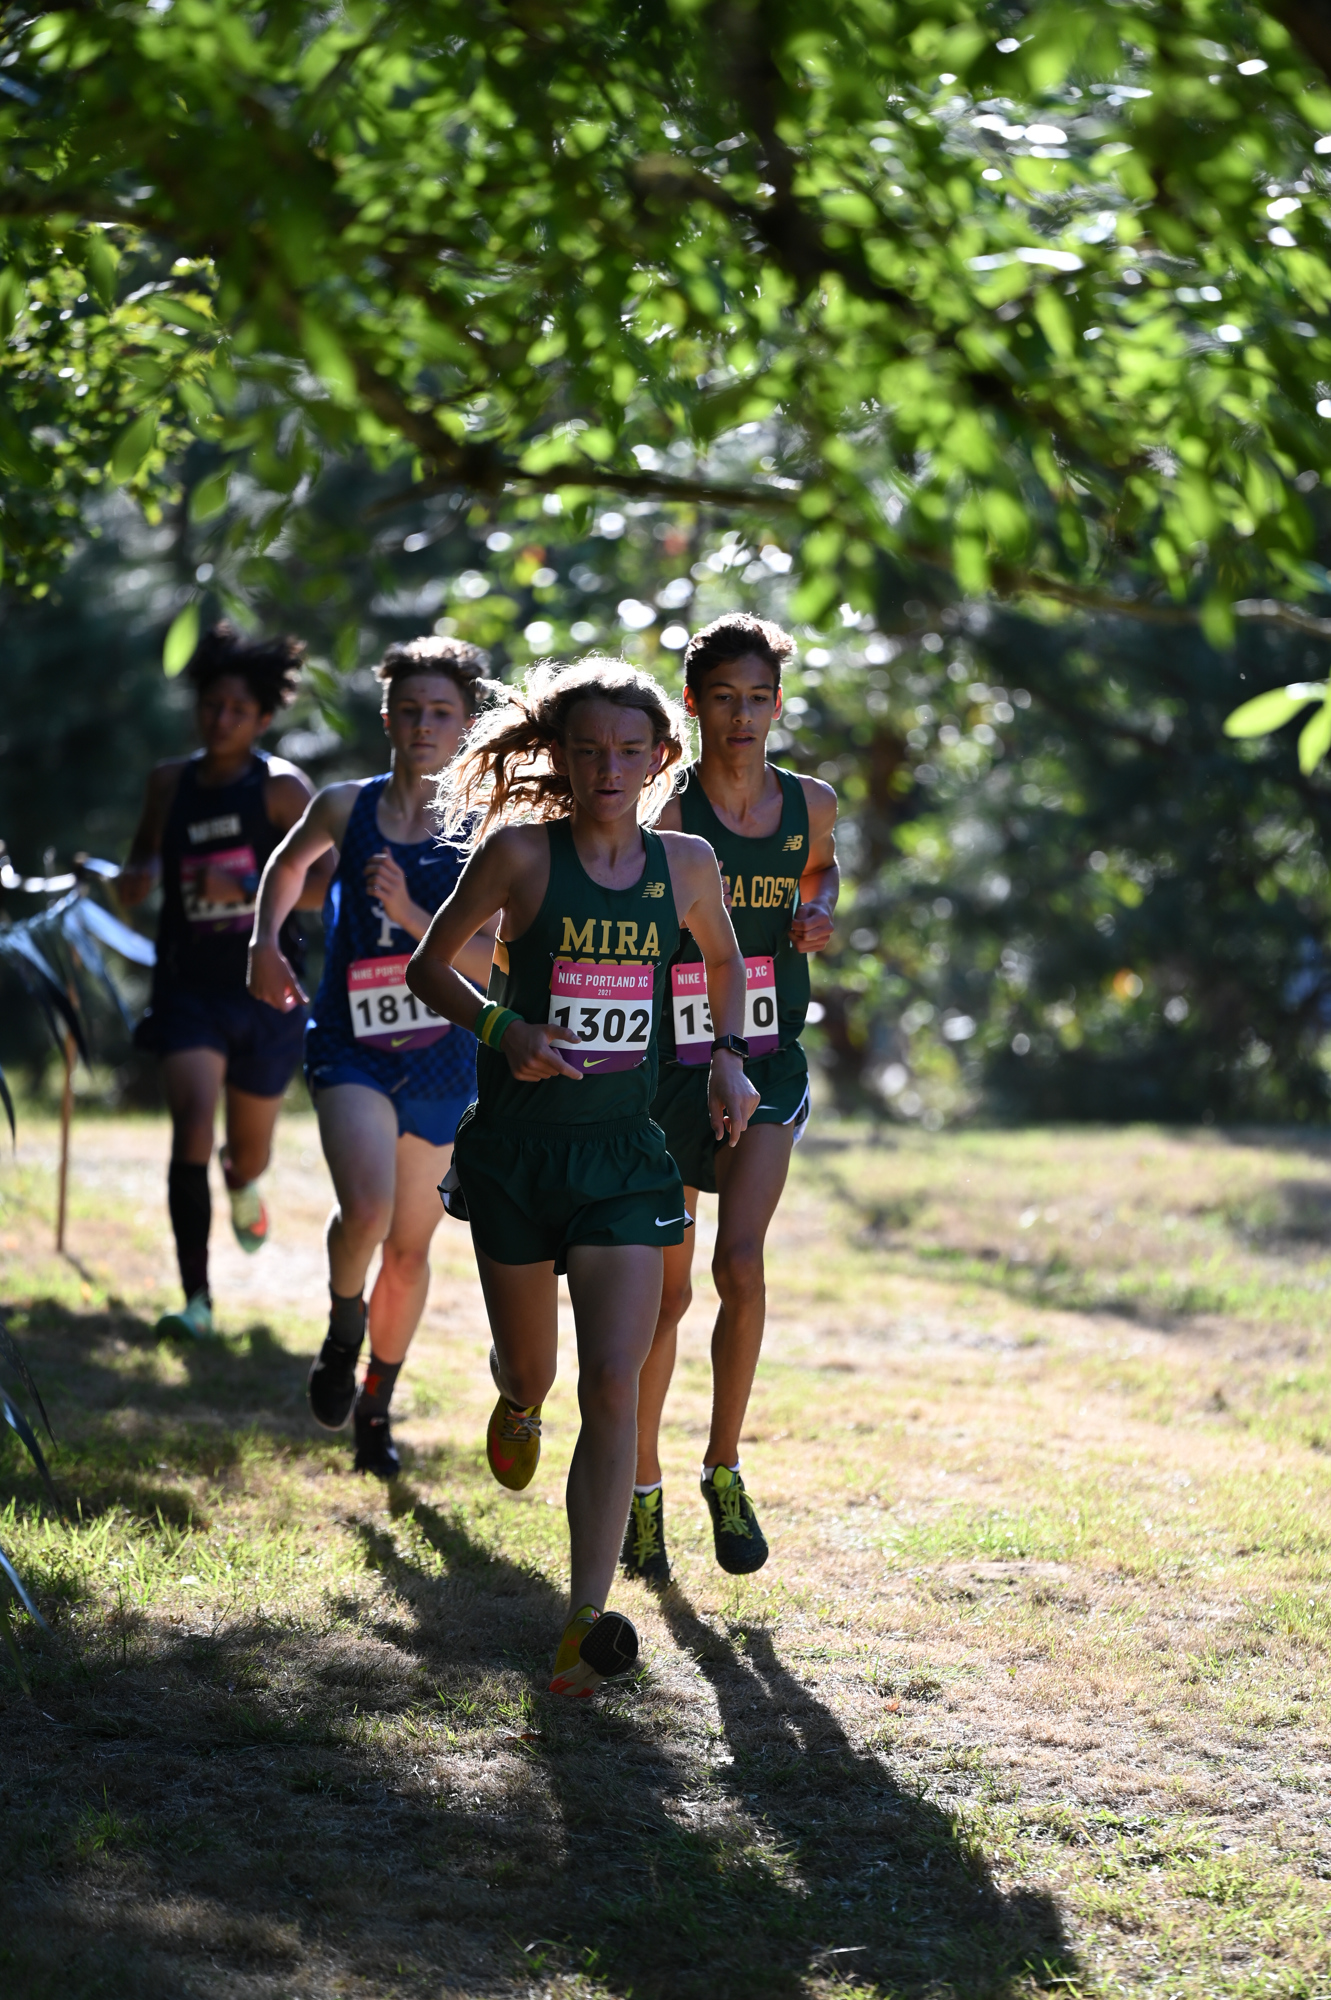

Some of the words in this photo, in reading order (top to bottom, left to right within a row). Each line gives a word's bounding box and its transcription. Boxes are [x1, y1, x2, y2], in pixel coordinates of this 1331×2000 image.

[559, 916, 661, 957] MIRA
[558, 972, 583, 986] NIKE
[585, 974, 636, 988] PORTLAND
[637, 976, 649, 988] XC
[677, 972, 701, 985] NIKE
[755, 965, 768, 977] XC
[597, 988, 612, 996] 2021
[554, 1006, 650, 1043] 1302
[680, 996, 774, 1035] 130
